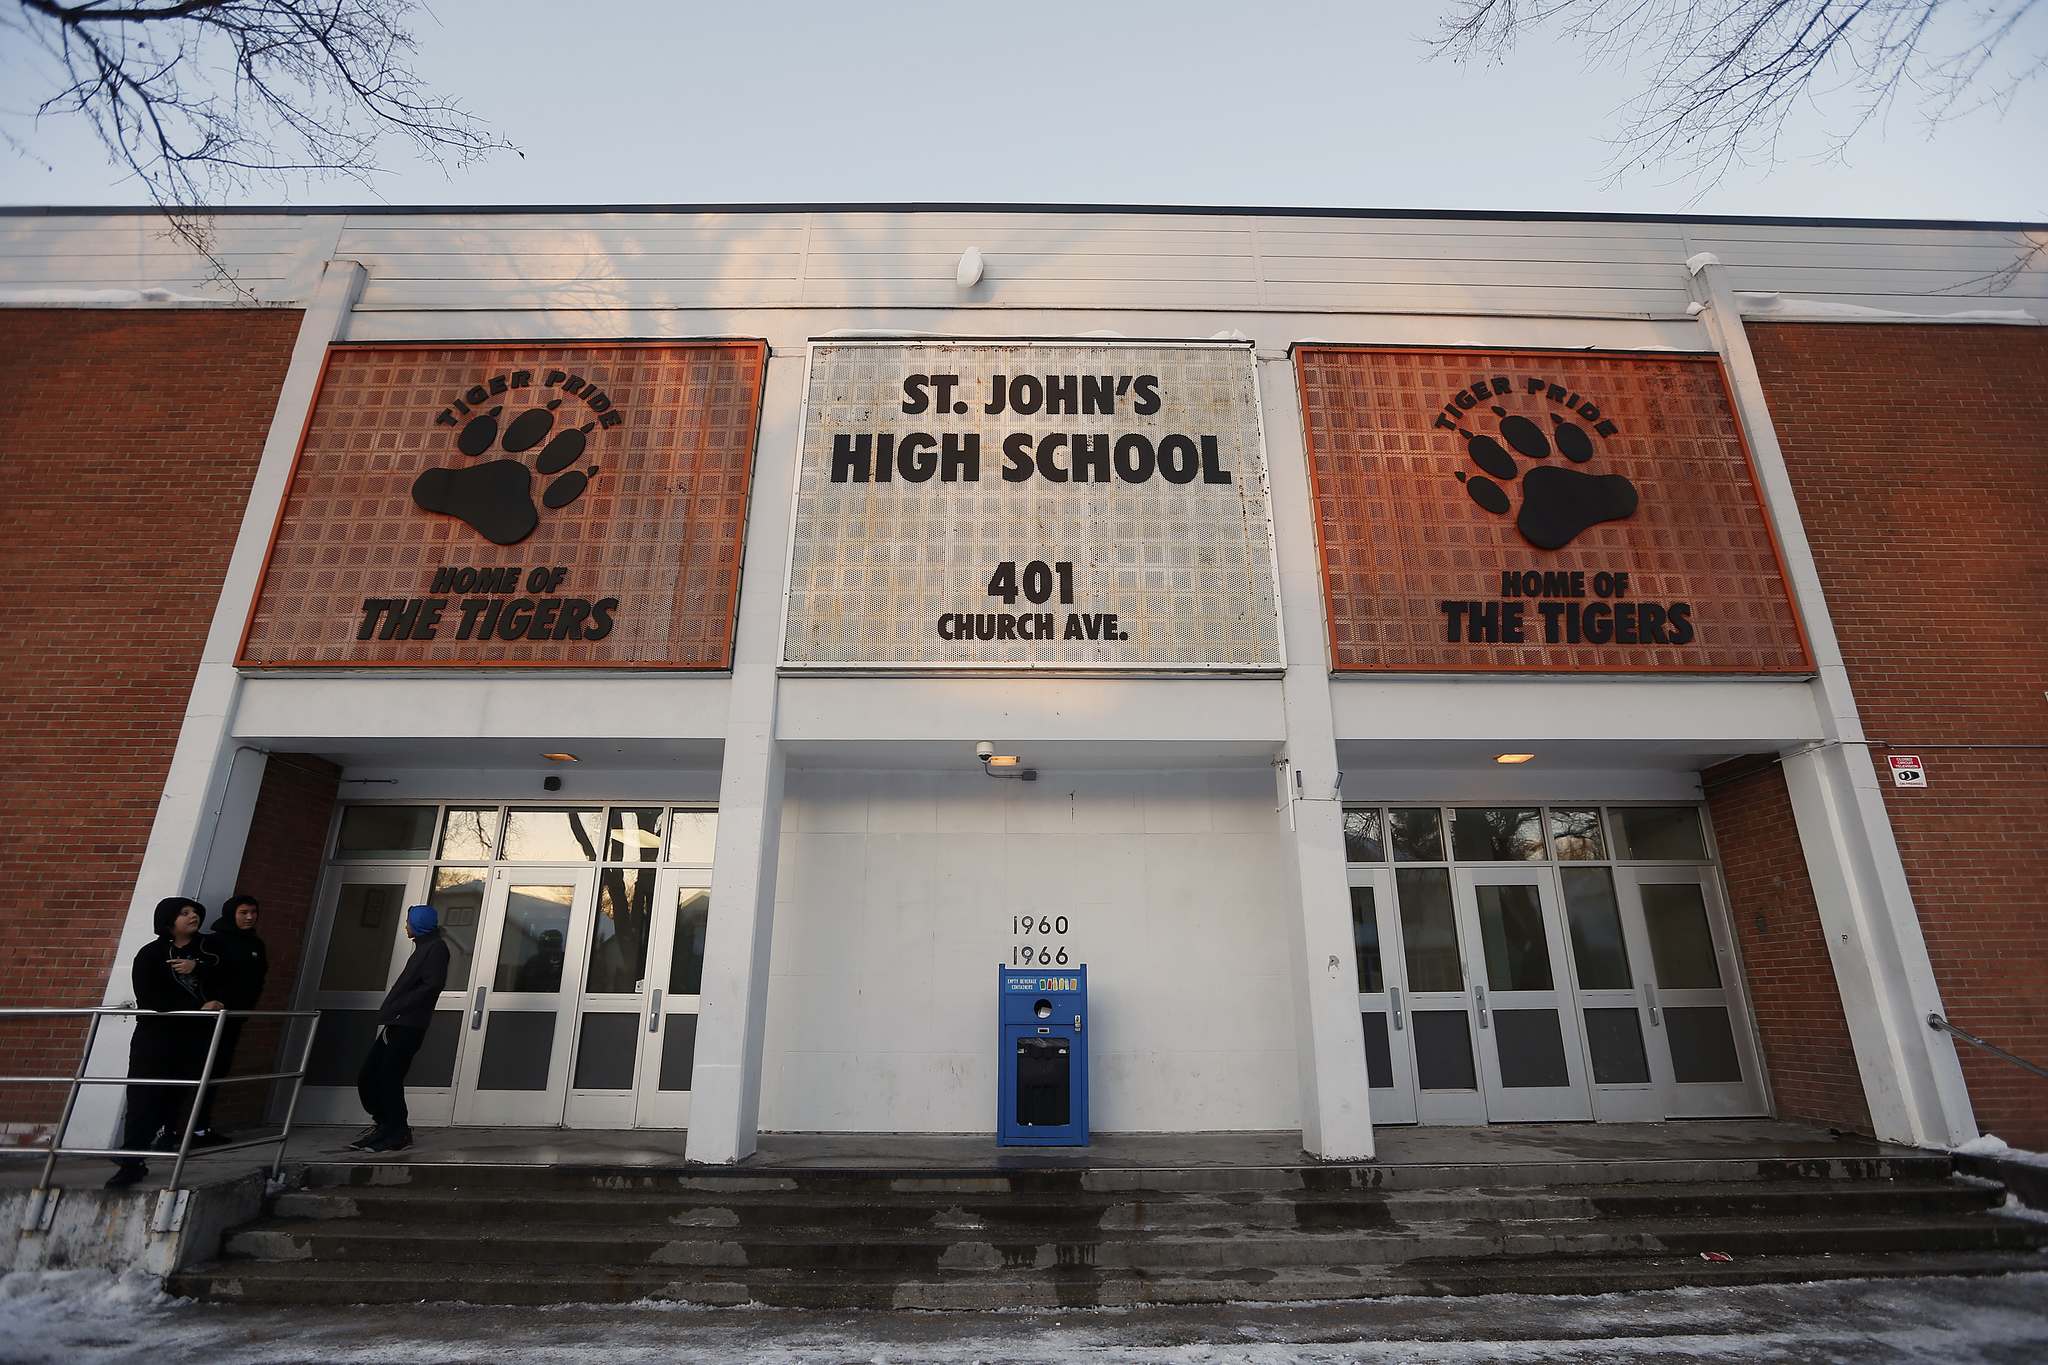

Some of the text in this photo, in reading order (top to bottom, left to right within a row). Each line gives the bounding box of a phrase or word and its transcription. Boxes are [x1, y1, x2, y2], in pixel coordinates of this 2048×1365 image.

[436, 370, 622, 430] TIGER PRIDE
[902, 374, 1162, 416] ST. JOHN'S
[1433, 377, 1619, 438] TIGER PRIDE
[830, 432, 1233, 485] HIGH SCHOOL
[429, 567, 568, 594] HOME OF
[987, 559, 1074, 606] 401
[1500, 570, 1630, 599] HOME OF
[356, 598, 619, 641] THE TIGERS
[937, 612, 1129, 641] CHURCH AVE.
[1441, 600, 1695, 645] THE TIGERS
[1013, 916, 1069, 935] 1960
[1013, 946, 1069, 966] 1966
